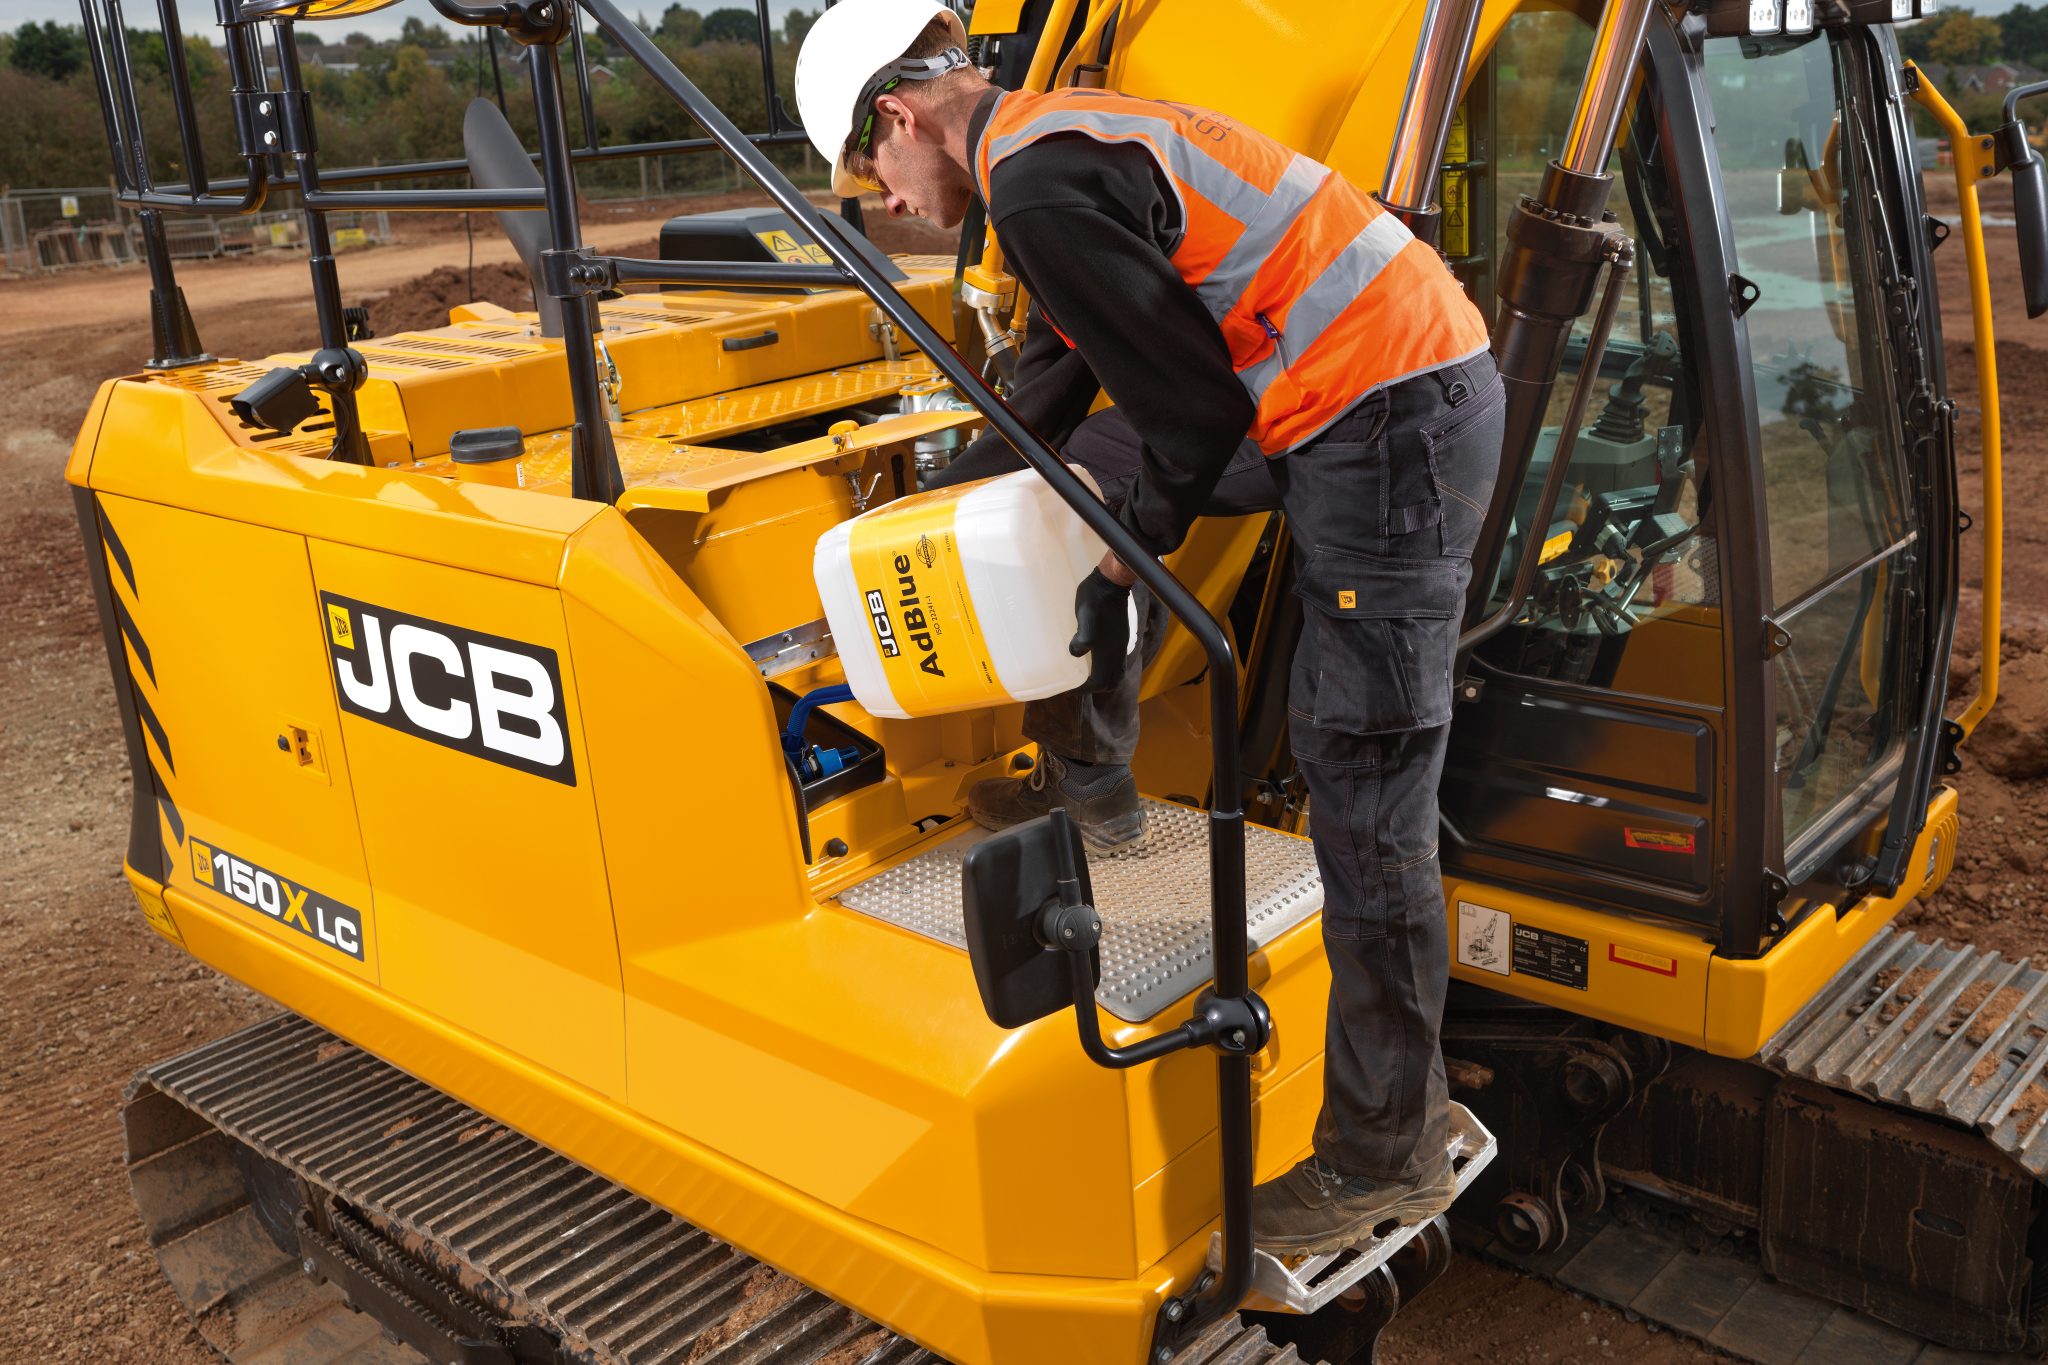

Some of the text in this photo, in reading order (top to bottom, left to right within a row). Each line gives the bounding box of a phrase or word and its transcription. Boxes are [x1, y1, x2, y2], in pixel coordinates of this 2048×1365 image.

[867, 591, 898, 656] JCB
[933, 622, 942, 636] ISO
[337, 613, 565, 767] JCB
[316, 907, 358, 954] LC
[1515, 928, 1539, 941] JCB
